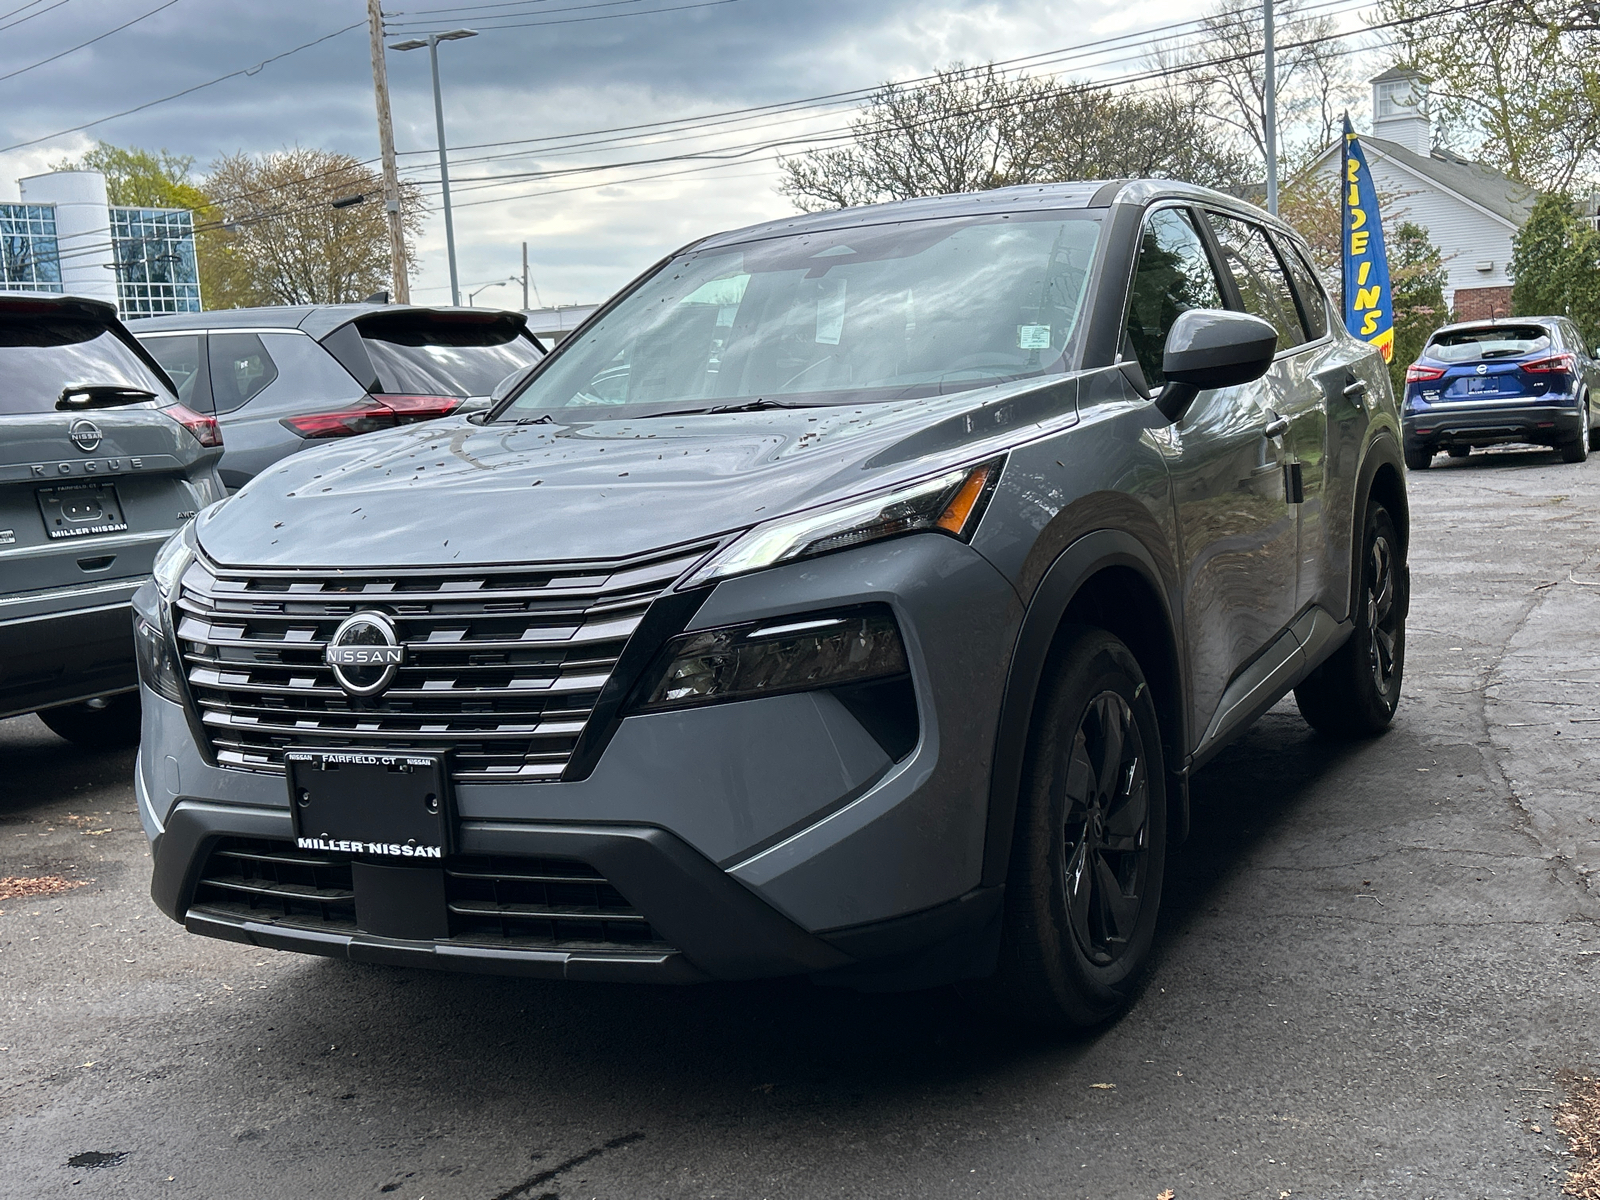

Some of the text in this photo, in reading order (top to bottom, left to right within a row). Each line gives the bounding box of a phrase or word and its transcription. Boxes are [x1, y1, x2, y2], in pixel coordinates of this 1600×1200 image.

[1354, 261, 1382, 335] INS
[71, 432, 103, 441] NISSAN
[31, 458, 143, 477] ROGUE
[177, 510, 196, 520] AWD
[51, 523, 128, 538] MILLER NISSAN
[326, 649, 401, 663] NISSAN
[289, 753, 313, 761] NISSAN
[322, 755, 397, 766] FAIRFIELD, CT
[406, 758, 431, 766] NISSAN
[297, 838, 441, 859] MILLER NISSAN
